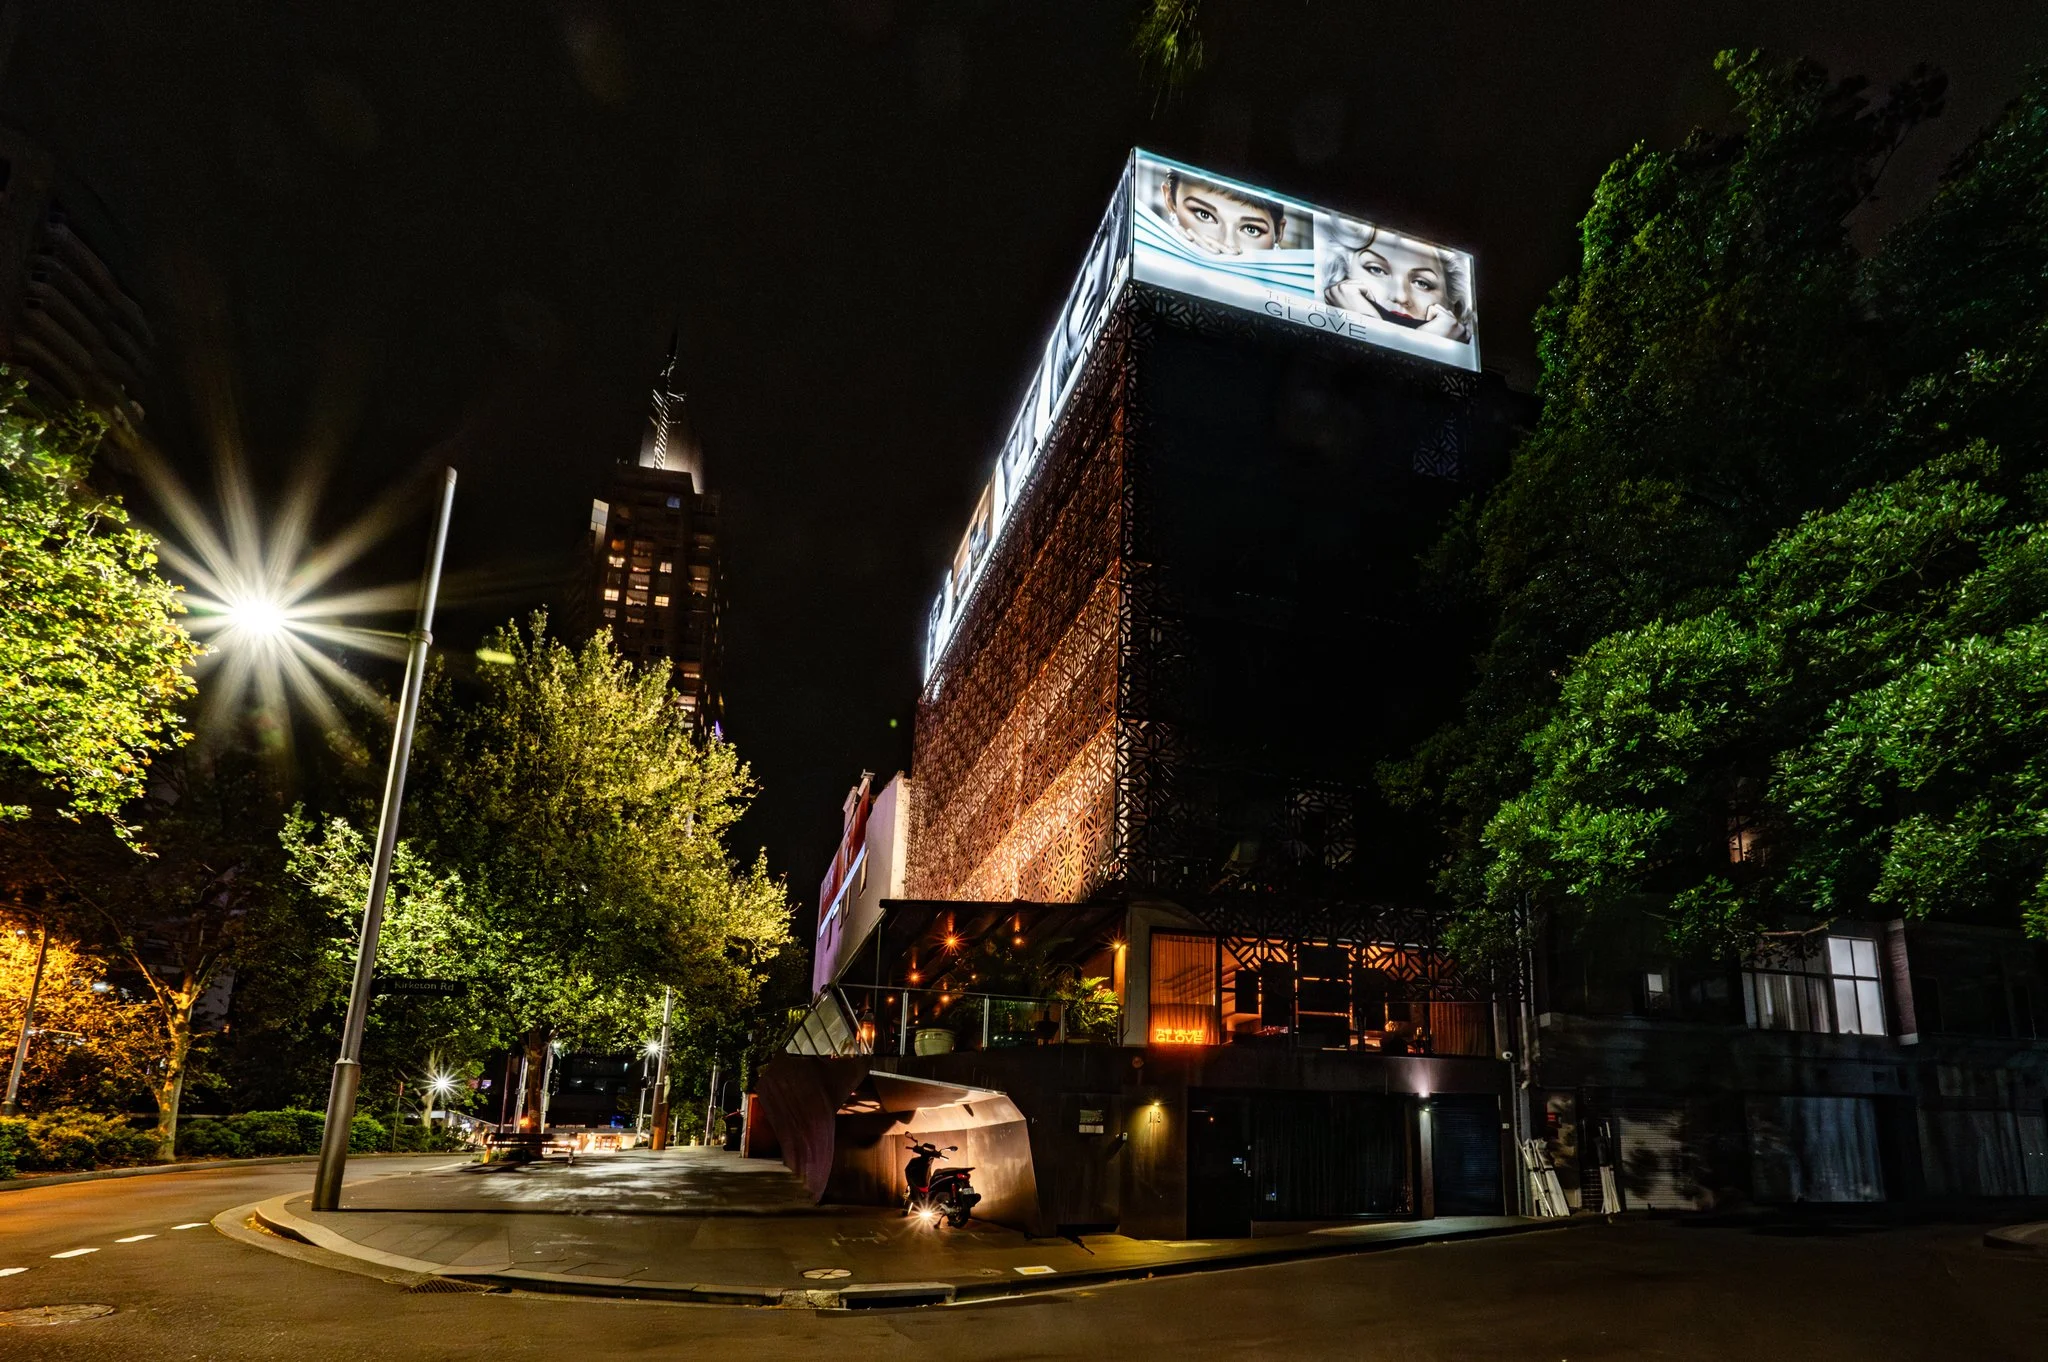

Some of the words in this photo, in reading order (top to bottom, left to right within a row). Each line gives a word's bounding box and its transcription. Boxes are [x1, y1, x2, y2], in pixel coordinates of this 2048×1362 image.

[1264, 300, 1367, 340] GLOVE
[440, 981, 455, 992] Rd
[1156, 1034, 1204, 1044] GLOVE
